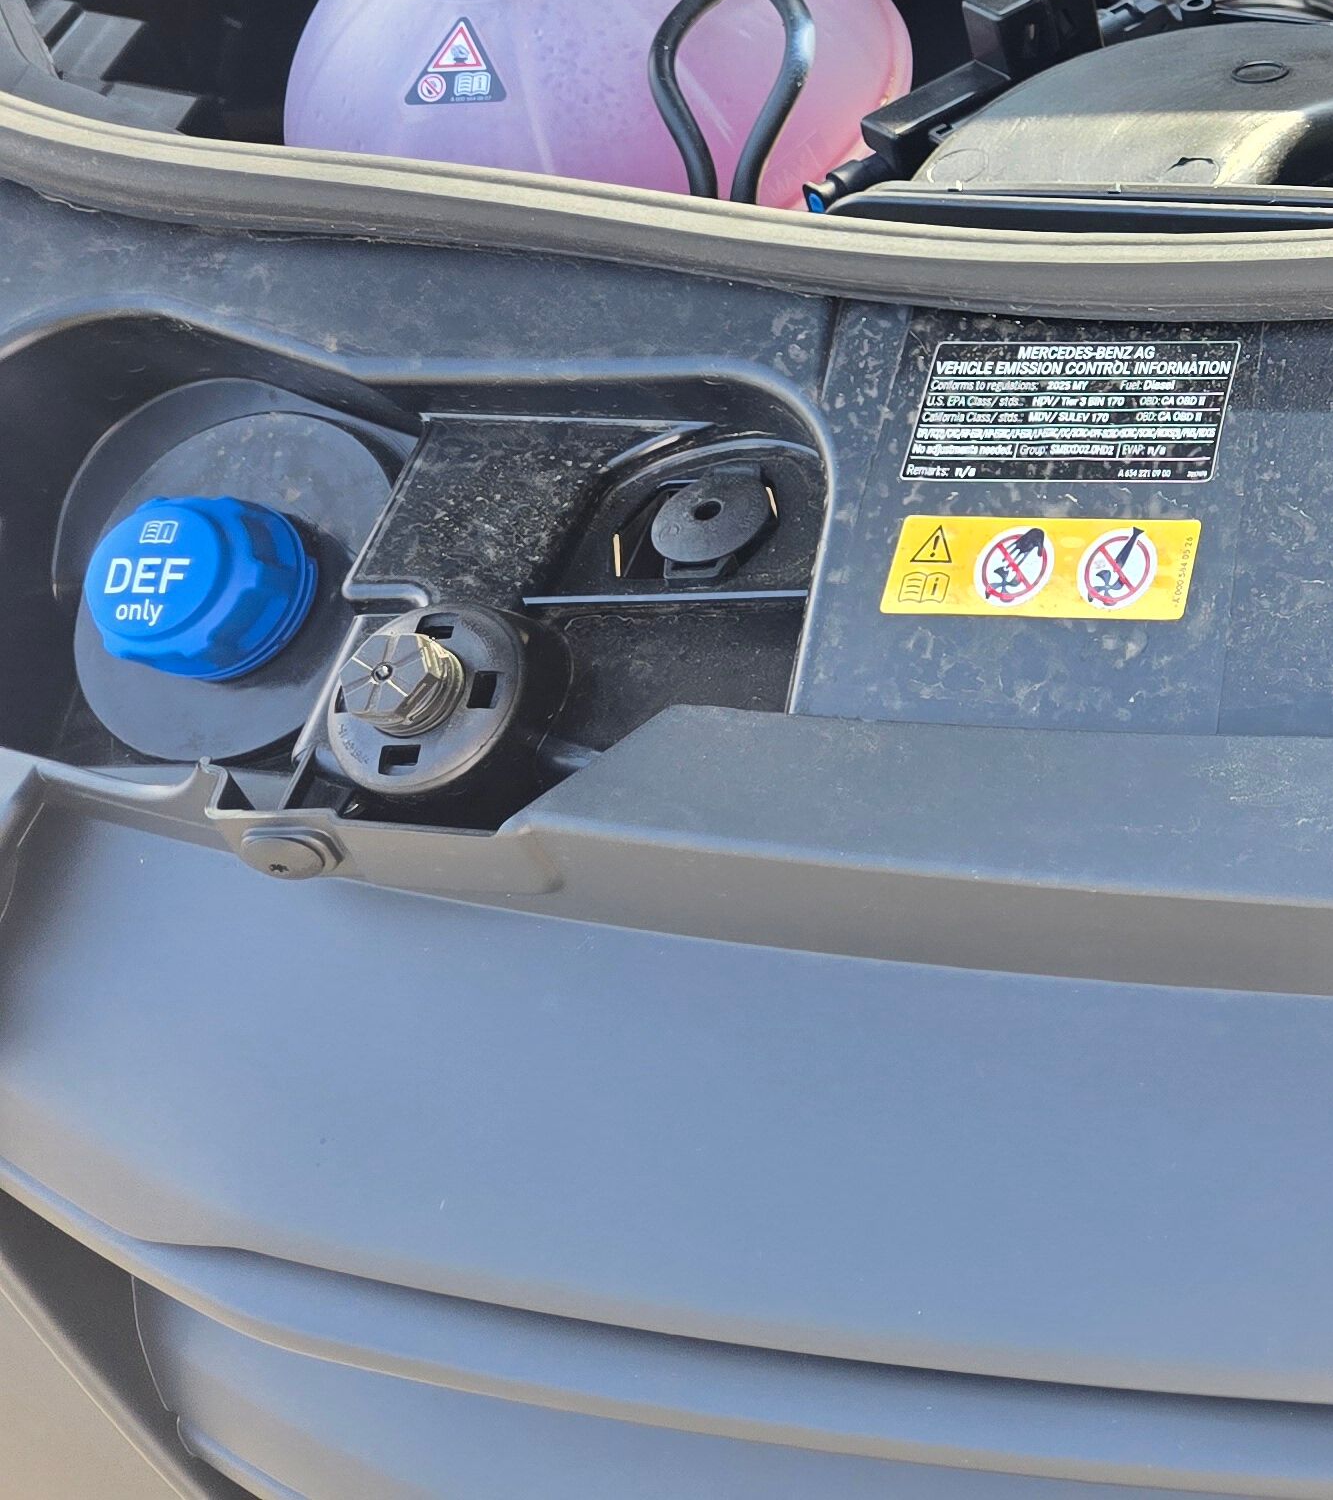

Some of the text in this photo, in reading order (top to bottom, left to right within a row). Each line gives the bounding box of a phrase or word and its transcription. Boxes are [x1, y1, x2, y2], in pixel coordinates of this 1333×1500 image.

[1017, 346, 1155, 360] MERCEDES-BENZ AG
[937, 361, 1231, 374] VEHICLE EMISSION CONTROL INFORMATION
[930, 380, 1176, 392] Conforms to regulations: 2025 MY Fuel: Diesel
[926, 396, 945, 406] U.S.
[947, 396, 965, 406] EPA
[1061, 397, 1079, 406] Tier
[1079, 397, 1087, 406] 3
[1088, 397, 1105, 406] BIN
[1108, 397, 1125, 406] 170
[1139, 396, 1161, 406] OBD:
[1161, 396, 1174, 406] CA
[1176, 396, 1197, 406] OBD
[922, 412, 965, 422] California
[1058, 412, 1090, 422] SULEV
[1092, 413, 1109, 422] 170
[1135, 412, 1157, 422] OBD:
[1158, 412, 1171, 422] CA
[1173, 412, 1194, 421] OBD
[912, 444, 1166, 456] No adjustments needed. Group: EVAP: n/a
[906, 464, 976, 478] Remarks: n/a
[104, 557, 191, 626] DEF only
